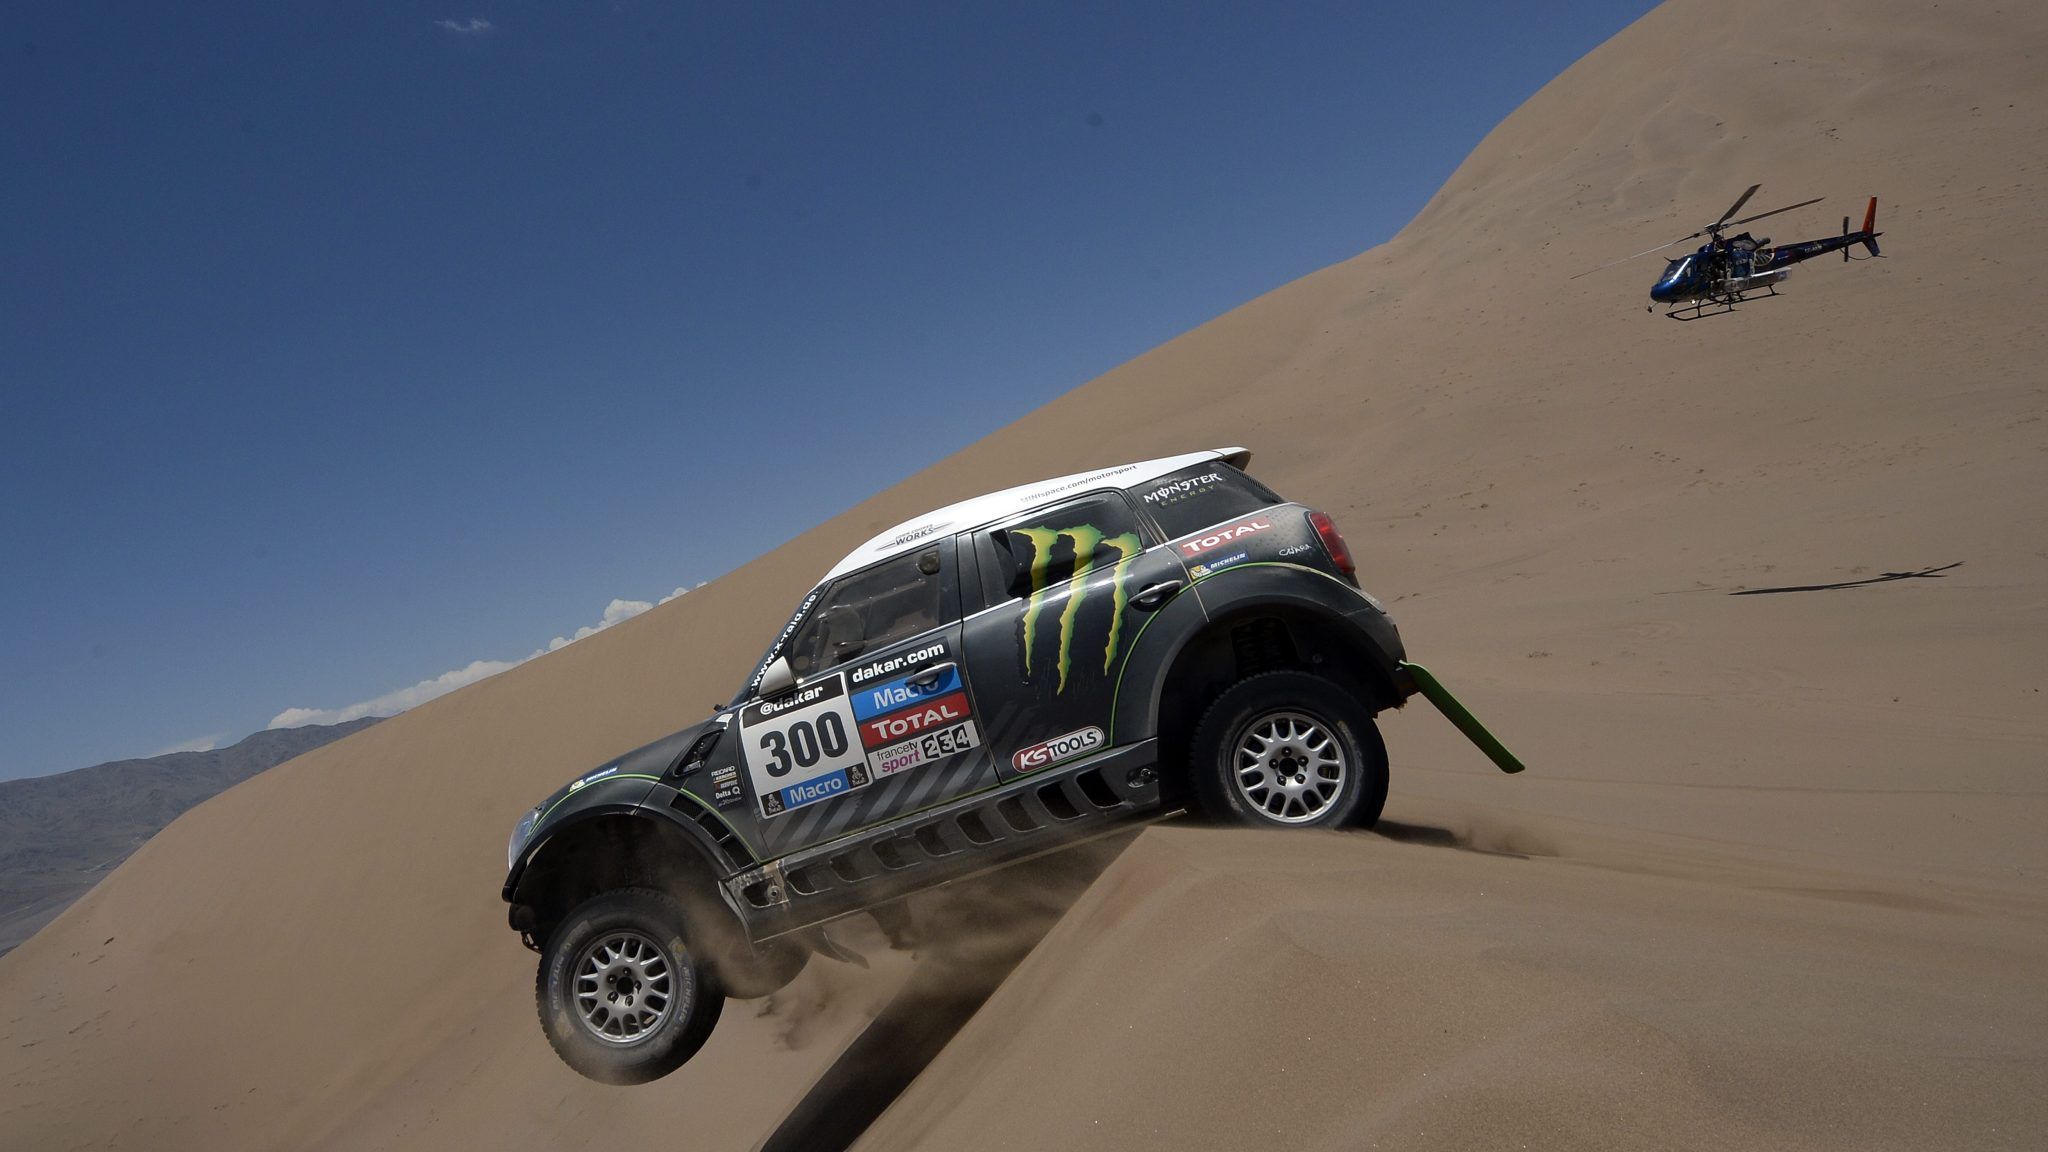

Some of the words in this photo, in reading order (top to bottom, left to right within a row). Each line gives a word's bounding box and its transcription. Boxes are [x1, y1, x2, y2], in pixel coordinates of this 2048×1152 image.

[1143, 472, 1223, 504] MONSTER
[895, 527, 934, 546] WORKS
[1182, 521, 1271, 553] TOTAL
[1210, 552, 1246, 569] MICHELIN
[852, 643, 945, 683] dakar.com
[760, 685, 824, 715] @dakar
[872, 705, 959, 739] TOTAL
[759, 711, 849, 778] 300
[877, 741, 918, 761] francetv
[882, 749, 920, 773] sport
[789, 778, 842, 804] Macro
